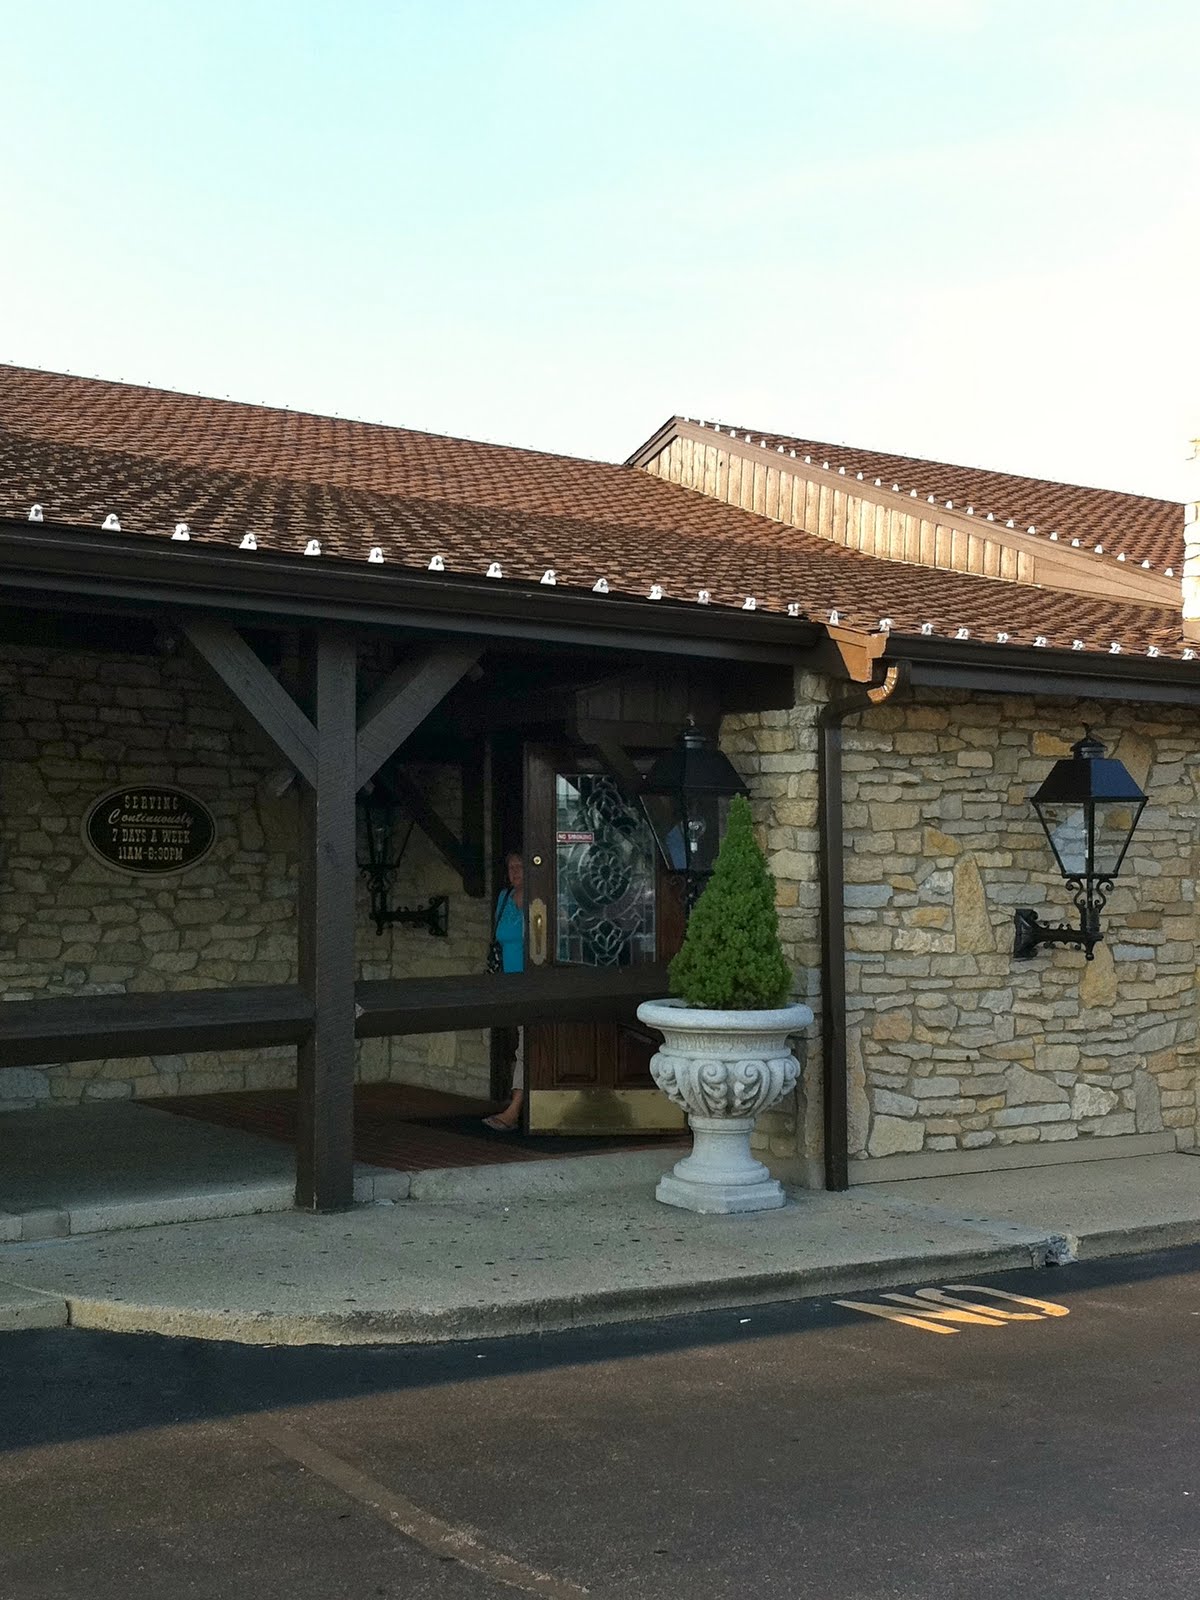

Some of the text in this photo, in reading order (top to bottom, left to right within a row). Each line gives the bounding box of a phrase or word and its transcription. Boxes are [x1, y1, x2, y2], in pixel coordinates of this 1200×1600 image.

[124, 795, 178, 810] SERVING
[108, 808, 193, 828] Continuously
[112, 828, 190, 844] 7 DAYS A WEEK
[832, 1284, 1070, 1334] NO
